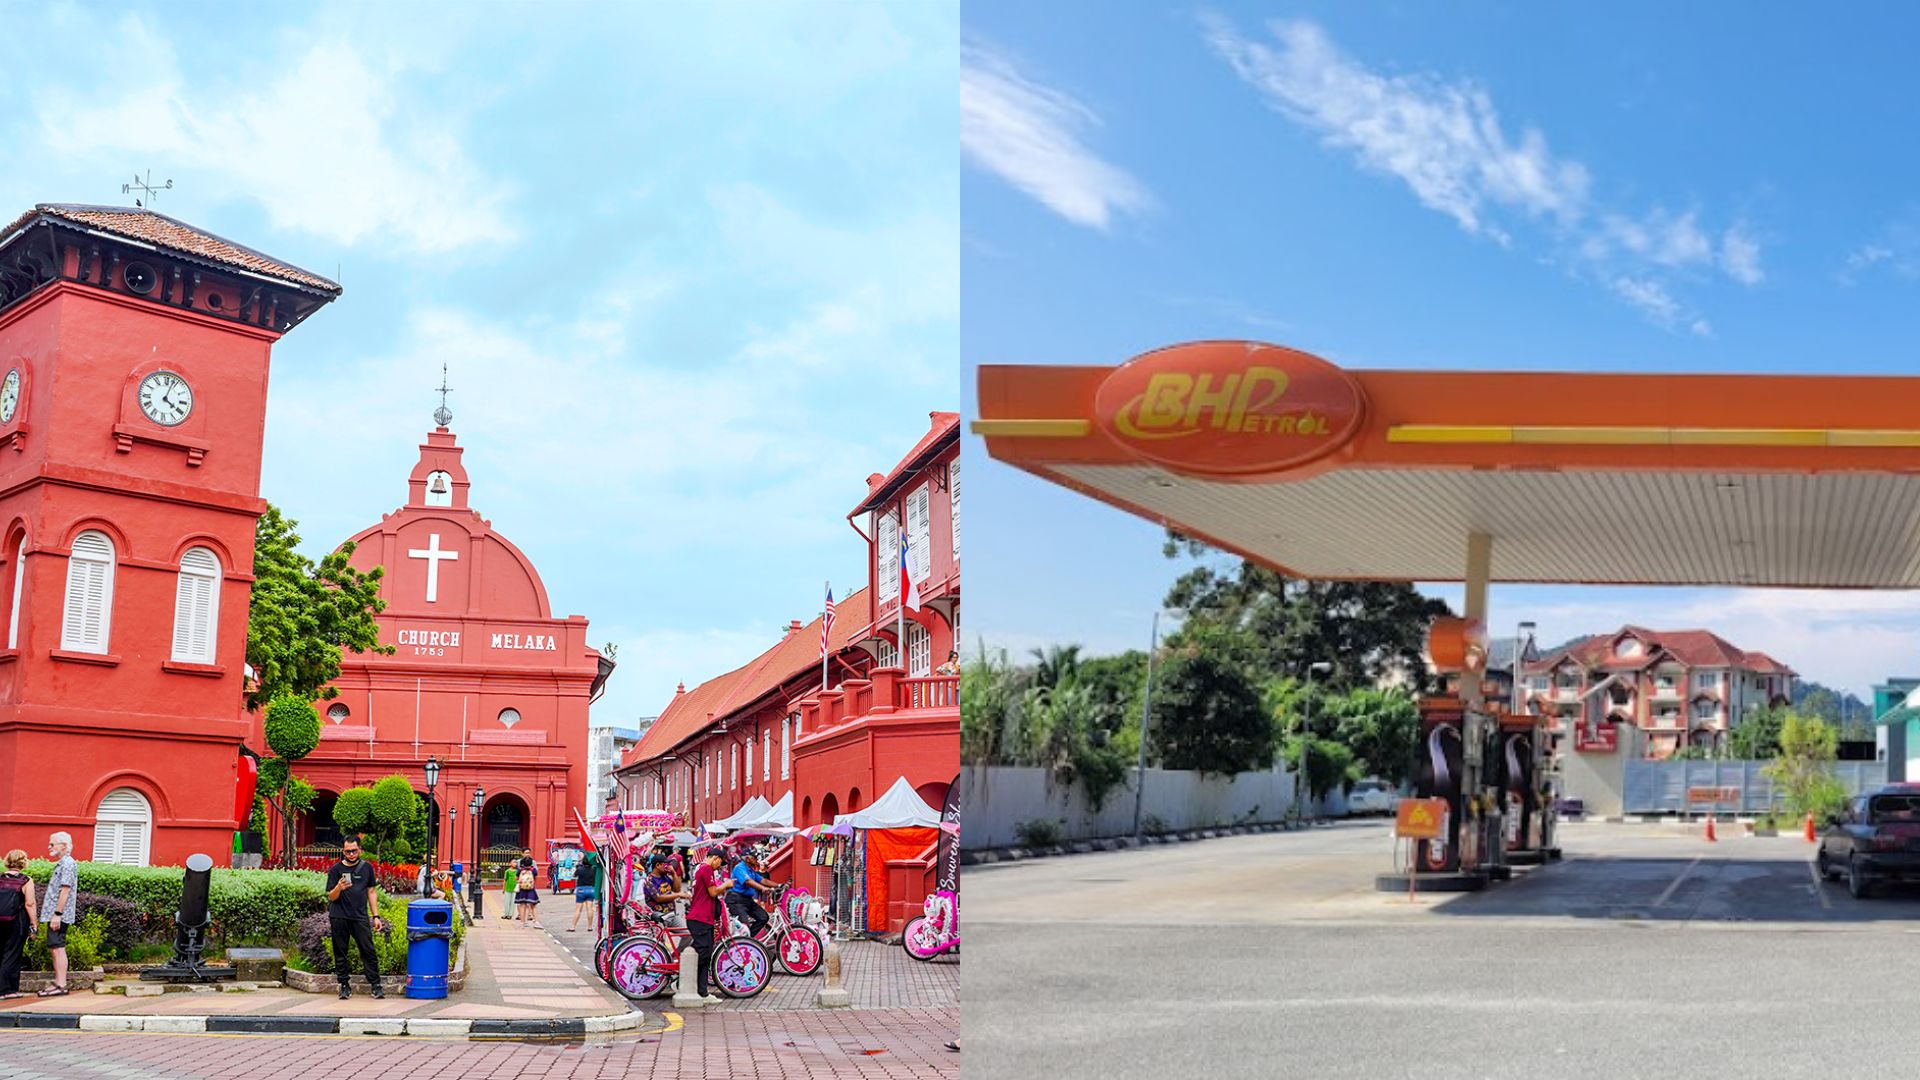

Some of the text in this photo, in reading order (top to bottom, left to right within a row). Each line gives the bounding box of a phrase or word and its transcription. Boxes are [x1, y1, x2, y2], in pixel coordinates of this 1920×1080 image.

[398, 630, 556, 651] CHURCH MELAKA
[414, 647, 444, 656] 1753
[940, 834, 960, 891] Souveni
